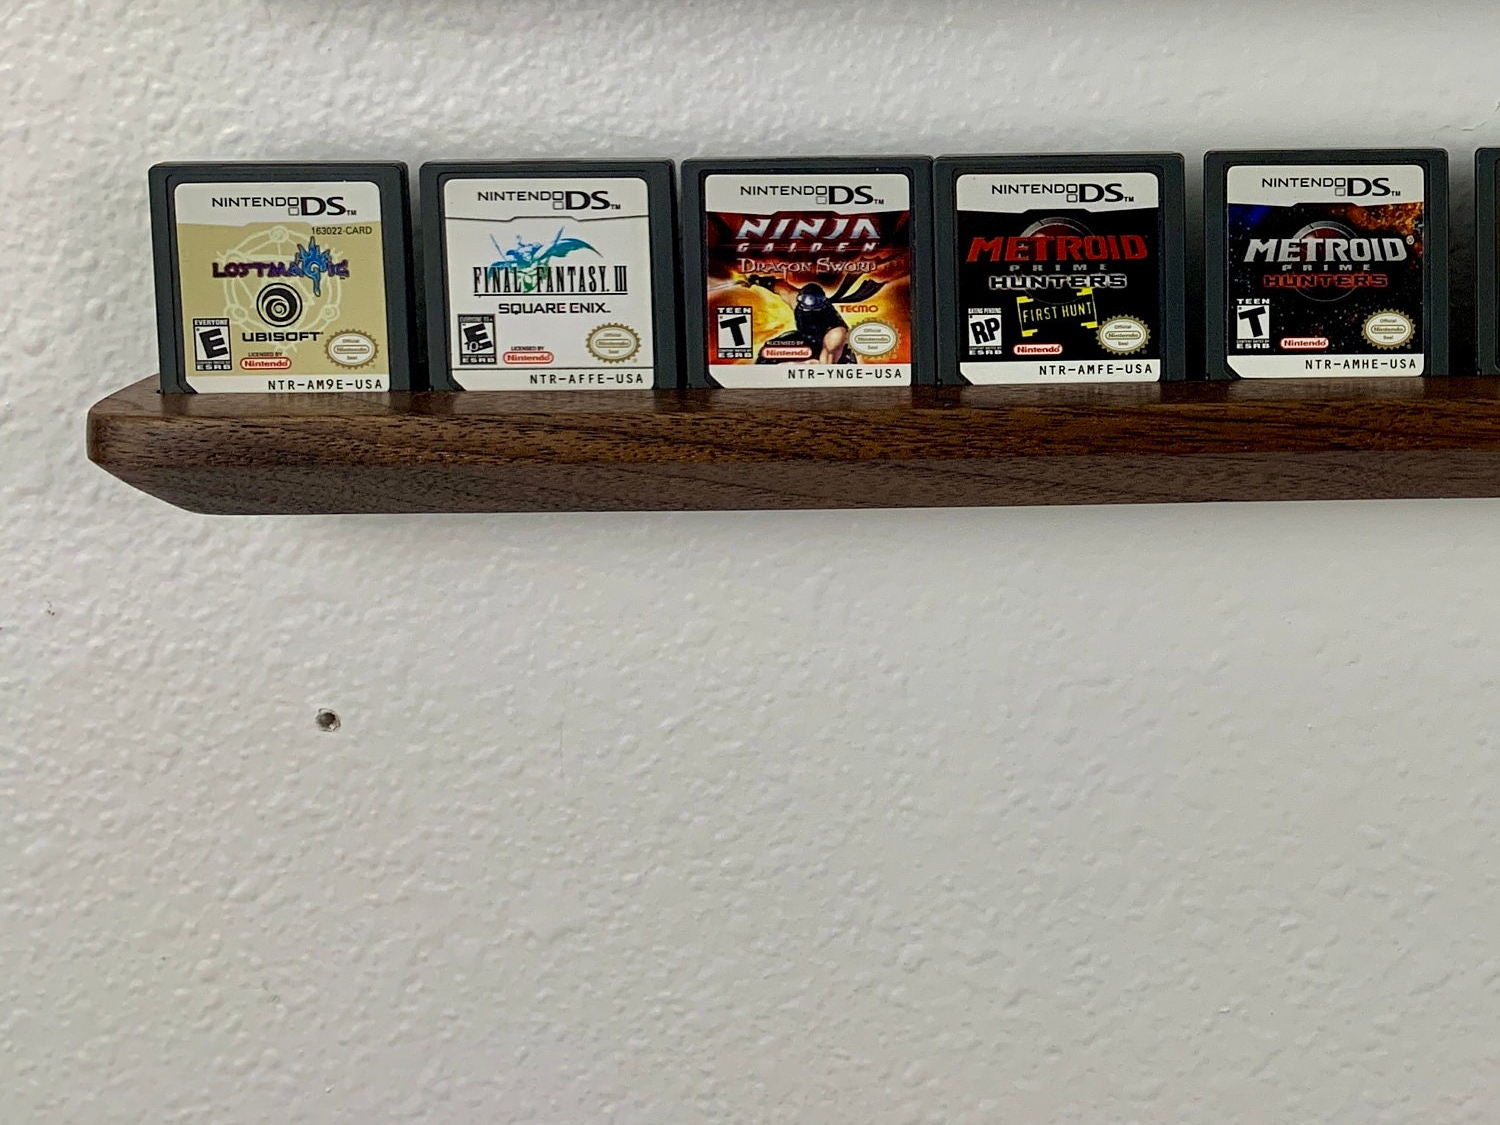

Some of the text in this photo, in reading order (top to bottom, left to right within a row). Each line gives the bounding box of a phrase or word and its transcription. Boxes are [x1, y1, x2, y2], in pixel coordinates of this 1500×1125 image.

[1262, 178, 1345, 188] NINTENDO
[741, 186, 827, 196] NINTENDO
[992, 184, 1077, 194] NINTENDO
[478, 192, 564, 201] NINTENDO
[212, 197, 299, 207] NINTENDO
[312, 227, 372, 235] 163022-CARD
[736, 218, 880, 240] NINJA
[966, 235, 1148, 263] METROID
[1243, 238, 1407, 262] METROID
[473, 267, 523, 293] FINAL
[989, 274, 1127, 290] HUNTERS
[1263, 274, 1389, 288] HUNTERS
[498, 303, 566, 314] SQUARE
[840, 305, 878, 313] TECMO
[1022, 301, 1093, 323] FIRST HUNT
[970, 317, 1000, 344] RP
[242, 332, 320, 341] UBISOFT
[1305, 359, 1416, 369] NTR-AMHE-USA
[788, 369, 902, 379] NTR-YNGE-USA
[1039, 364, 1152, 375] NTR-AMFE-USA
[530, 374, 643, 384] NTR-AFFE-USA
[268, 379, 382, 390] NTR-AM9E-USA
